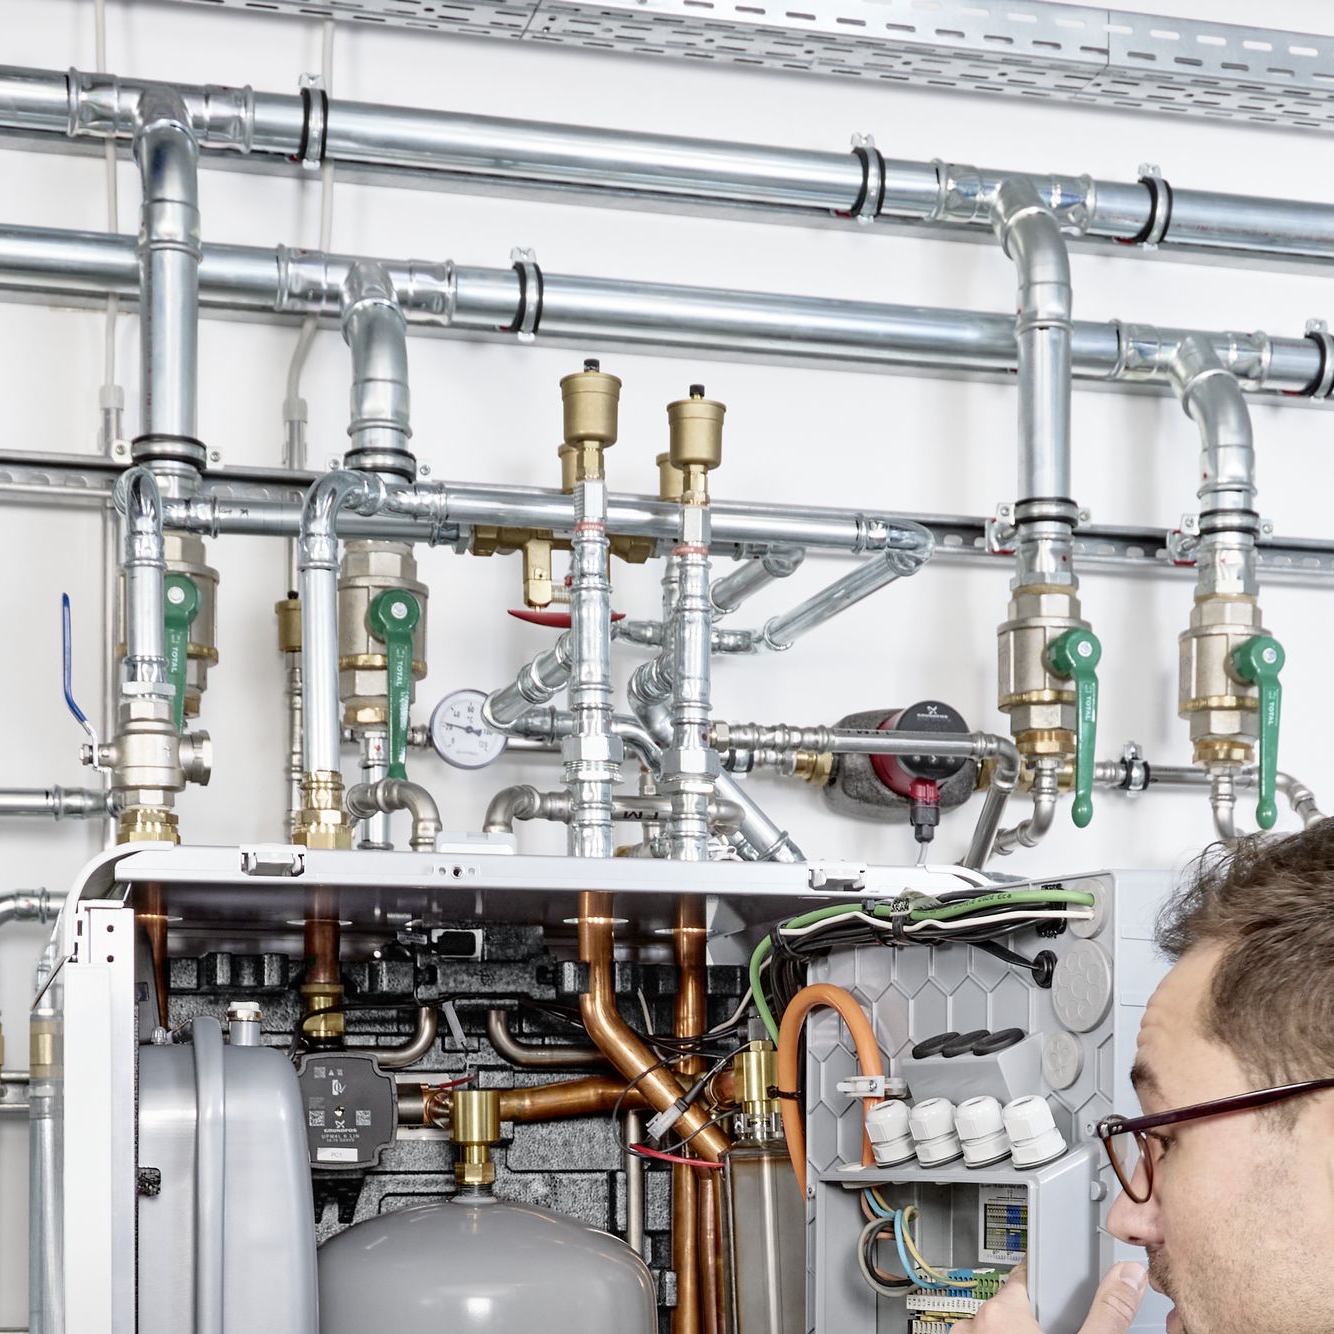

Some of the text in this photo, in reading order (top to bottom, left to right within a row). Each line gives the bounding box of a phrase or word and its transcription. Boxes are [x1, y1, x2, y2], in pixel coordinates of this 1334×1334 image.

[395, 661, 404, 687] TOTAL
[1084, 696, 1092, 721] TOTAL
[1267, 702, 1275, 726] TOTAL
